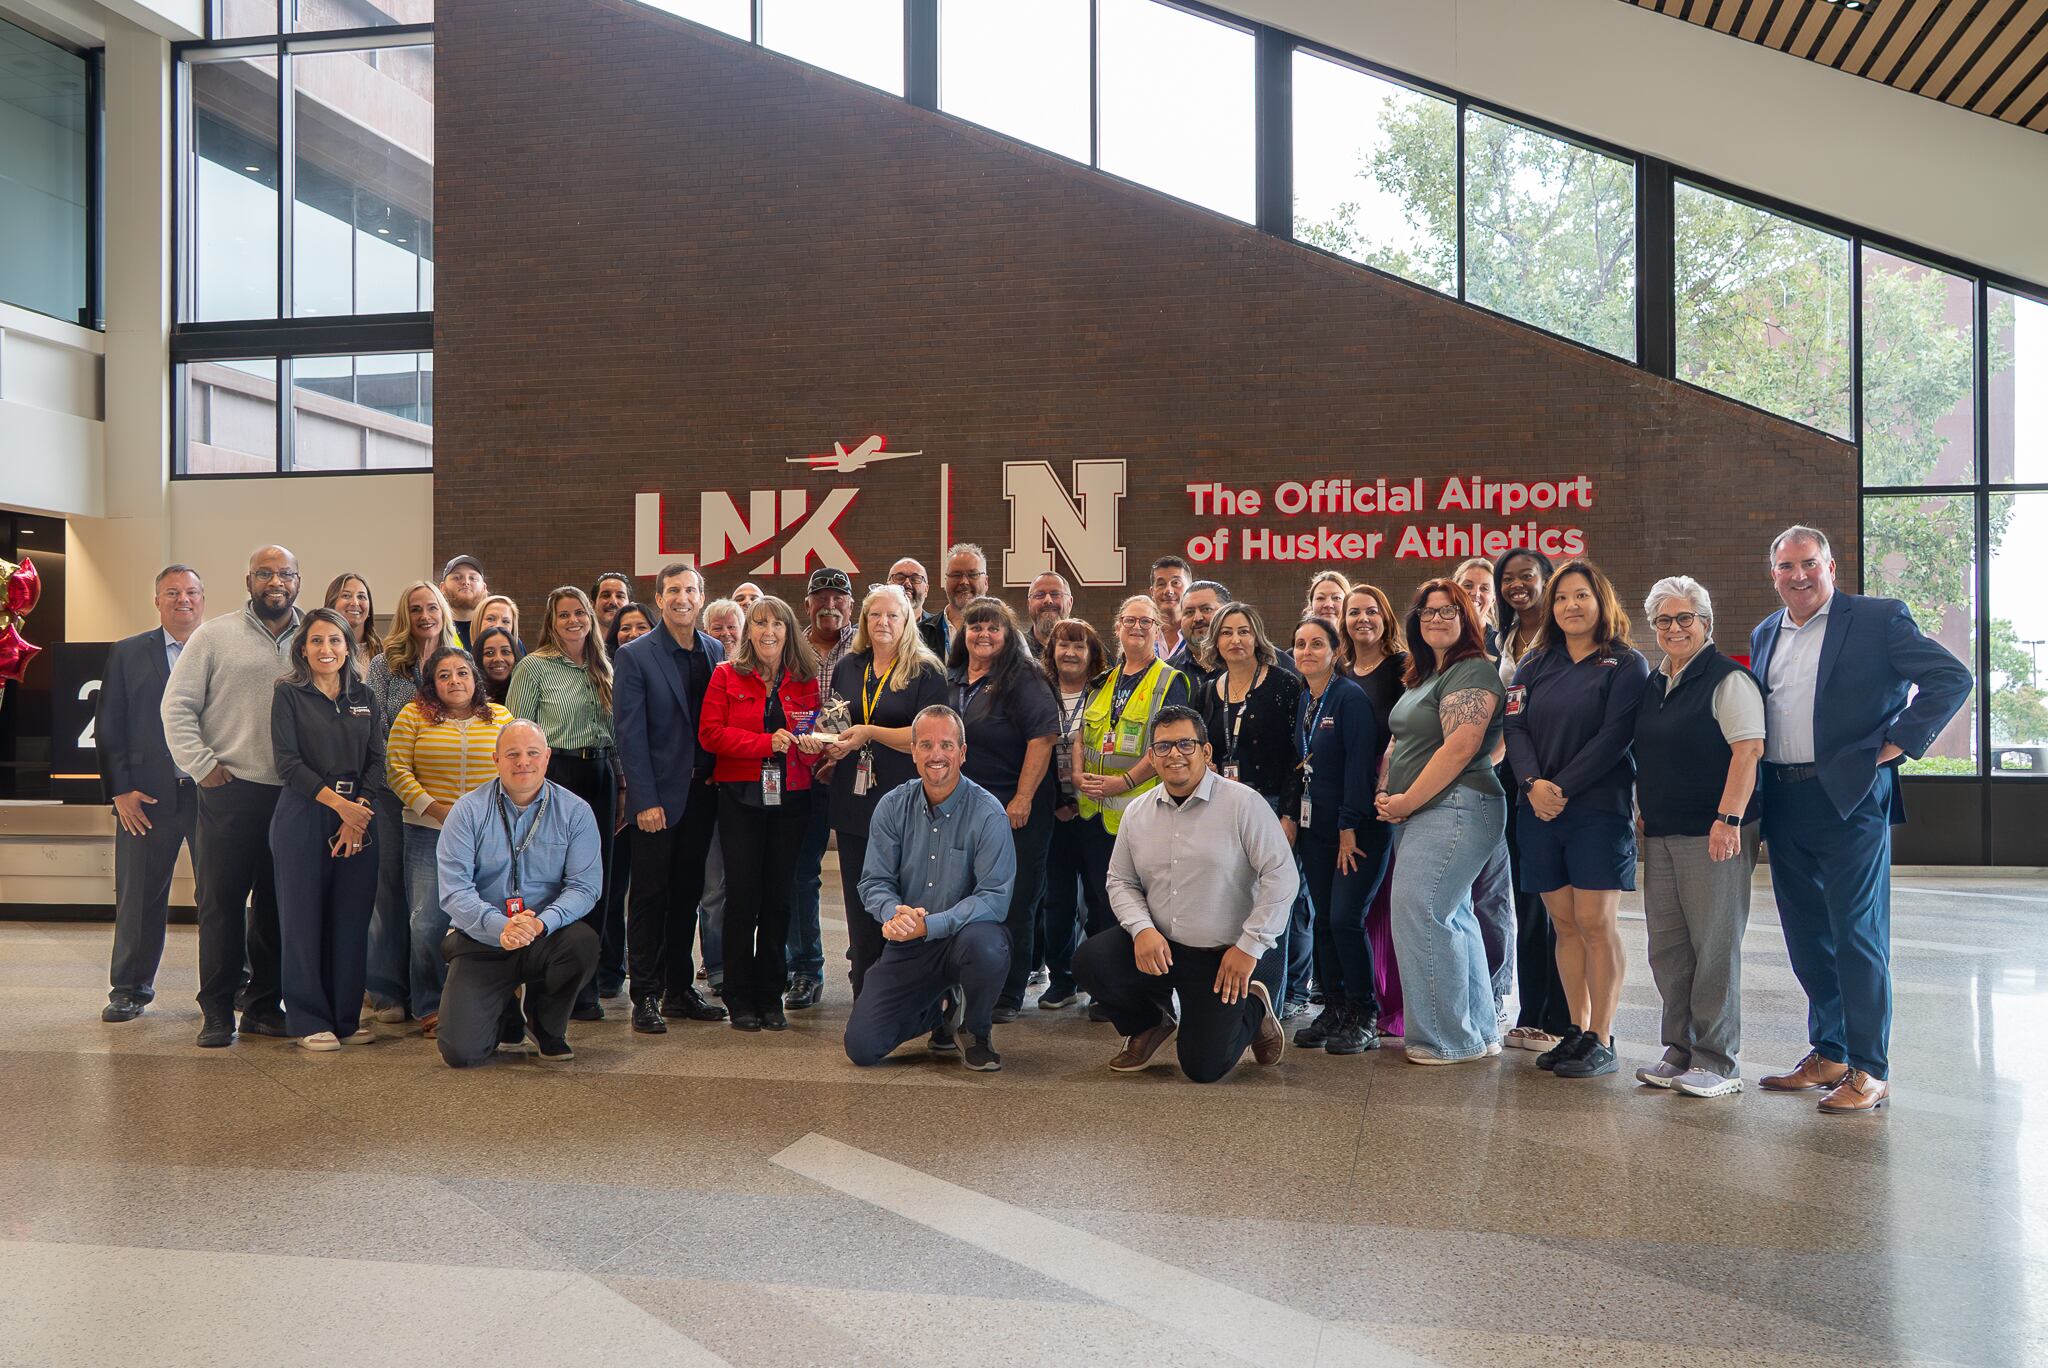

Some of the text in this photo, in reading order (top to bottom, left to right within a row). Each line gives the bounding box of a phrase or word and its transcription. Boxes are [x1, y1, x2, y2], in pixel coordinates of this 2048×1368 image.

[1003, 459, 1126, 587] N
[1186, 475, 1593, 516] The Official Airport
[635, 488, 860, 576] LNK
[1186, 521, 1584, 561] of Husker Athletics
